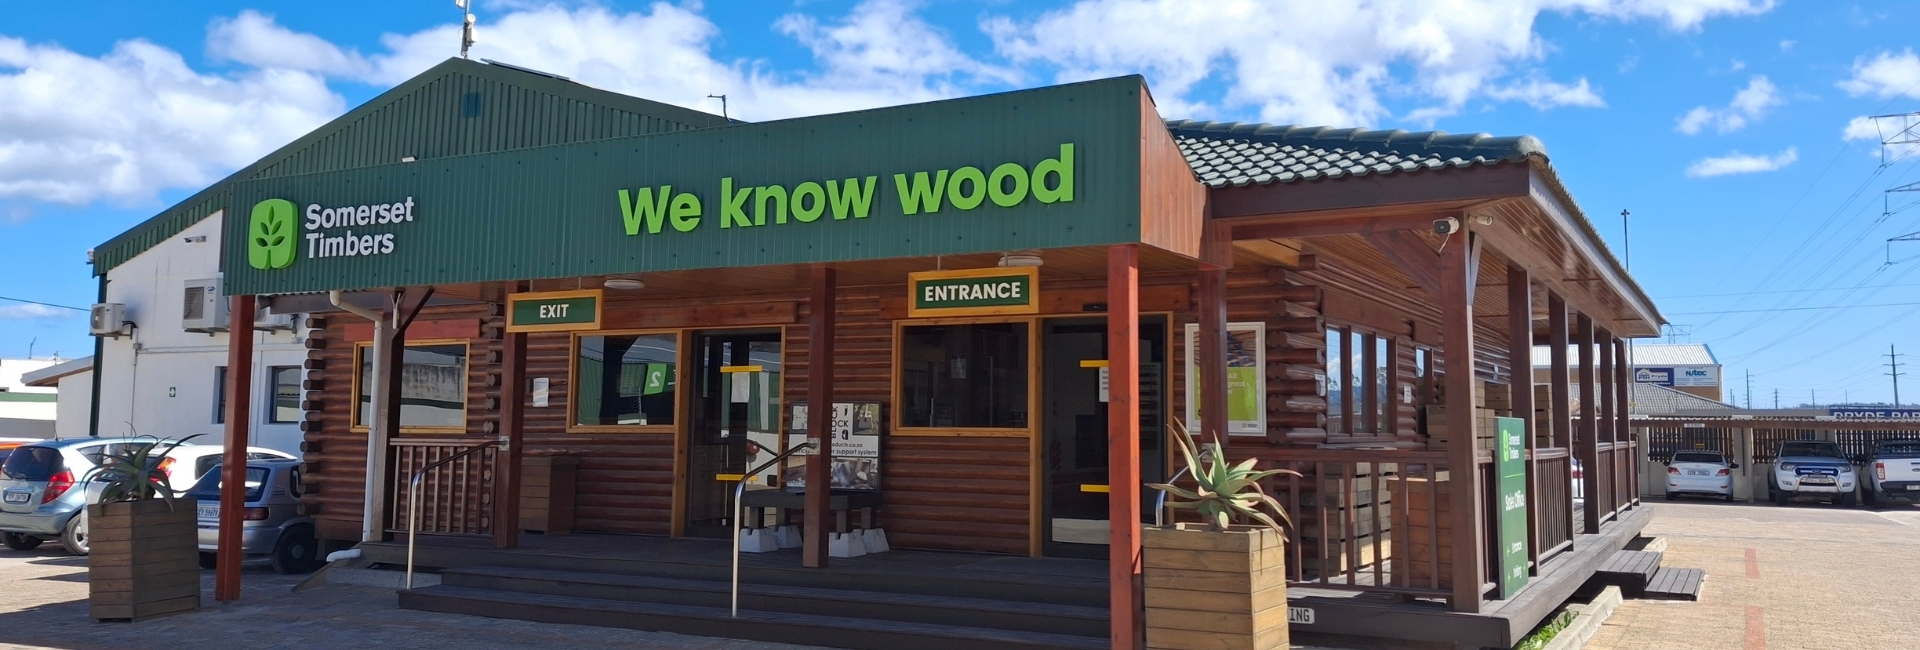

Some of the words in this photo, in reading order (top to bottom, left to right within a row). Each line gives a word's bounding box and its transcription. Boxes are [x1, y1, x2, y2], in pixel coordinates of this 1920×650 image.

[618, 184, 702, 236] We
[720, 175, 878, 229] know
[893, 142, 1075, 216] wood
[304, 196, 415, 231] Somerset
[305, 230, 395, 259] Timbers
[924, 281, 1021, 302] ENTRANCE
[539, 303, 570, 319] EXIT
[832, 420, 849, 428] OCK
[1290, 608, 1310, 622] ING
